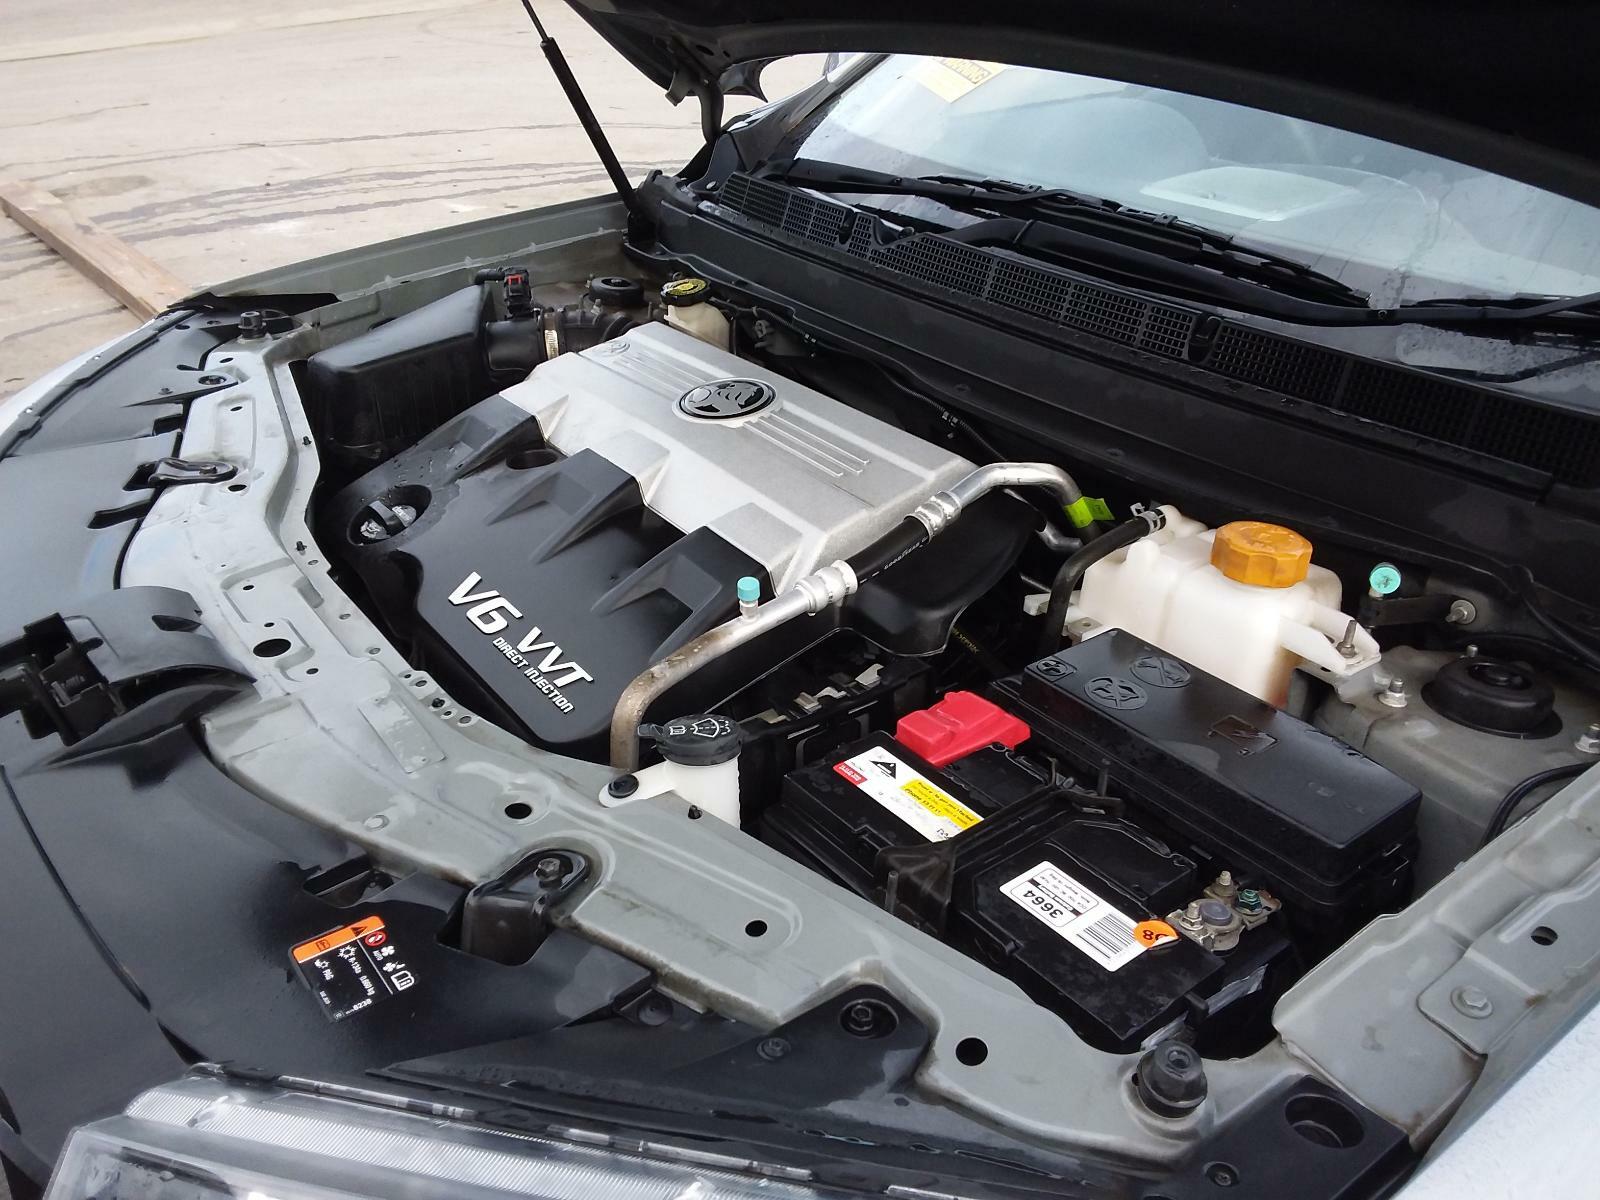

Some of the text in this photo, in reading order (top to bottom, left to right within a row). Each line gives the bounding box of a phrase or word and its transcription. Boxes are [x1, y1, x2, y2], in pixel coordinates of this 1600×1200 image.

[447, 571, 594, 688] V6 VVT
[492, 637, 575, 714] DIRECT INJECTION
[1023, 889, 1064, 919] 3664
